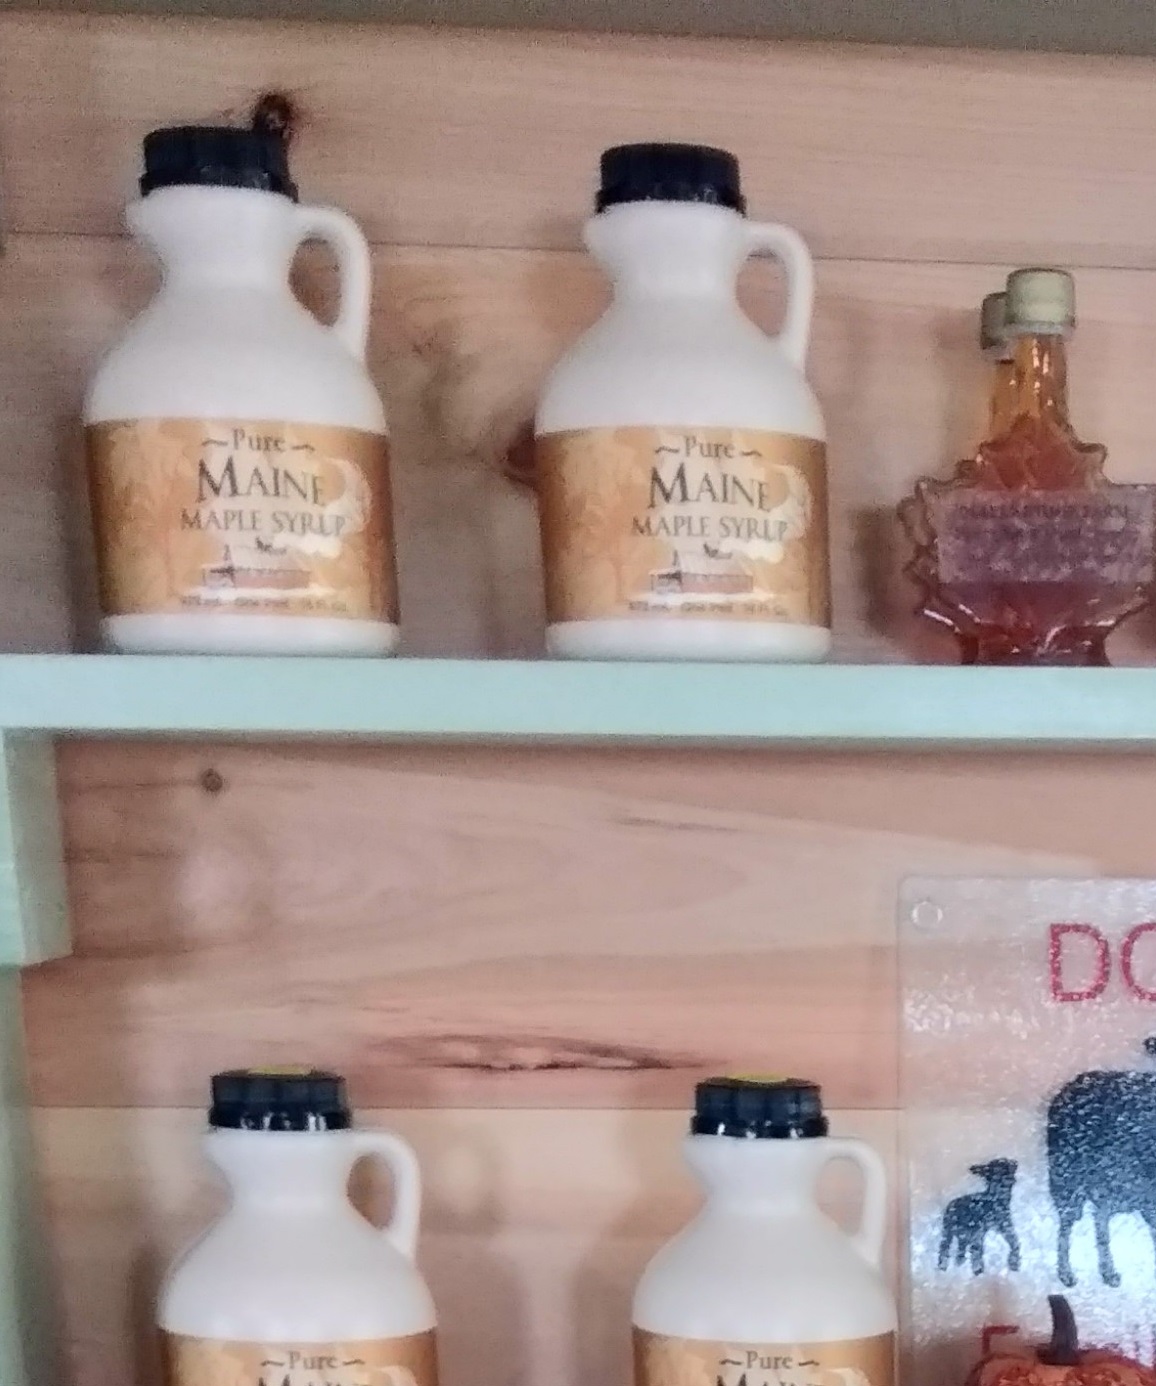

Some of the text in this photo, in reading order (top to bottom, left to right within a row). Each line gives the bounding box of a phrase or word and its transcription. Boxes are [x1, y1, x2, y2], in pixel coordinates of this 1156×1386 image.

[232, 428, 286, 450] Pure
[684, 435, 736, 457] Pure
[198, 456, 326, 505] MAINE
[647, 463, 770, 511] MAINE
[180, 508, 345, 536] MAPLE SYRUP
[632, 516, 789, 541] MAPLE SYRUP
[289, 1351, 338, 1369] Pure
[746, 1351, 794, 1369] Pure
